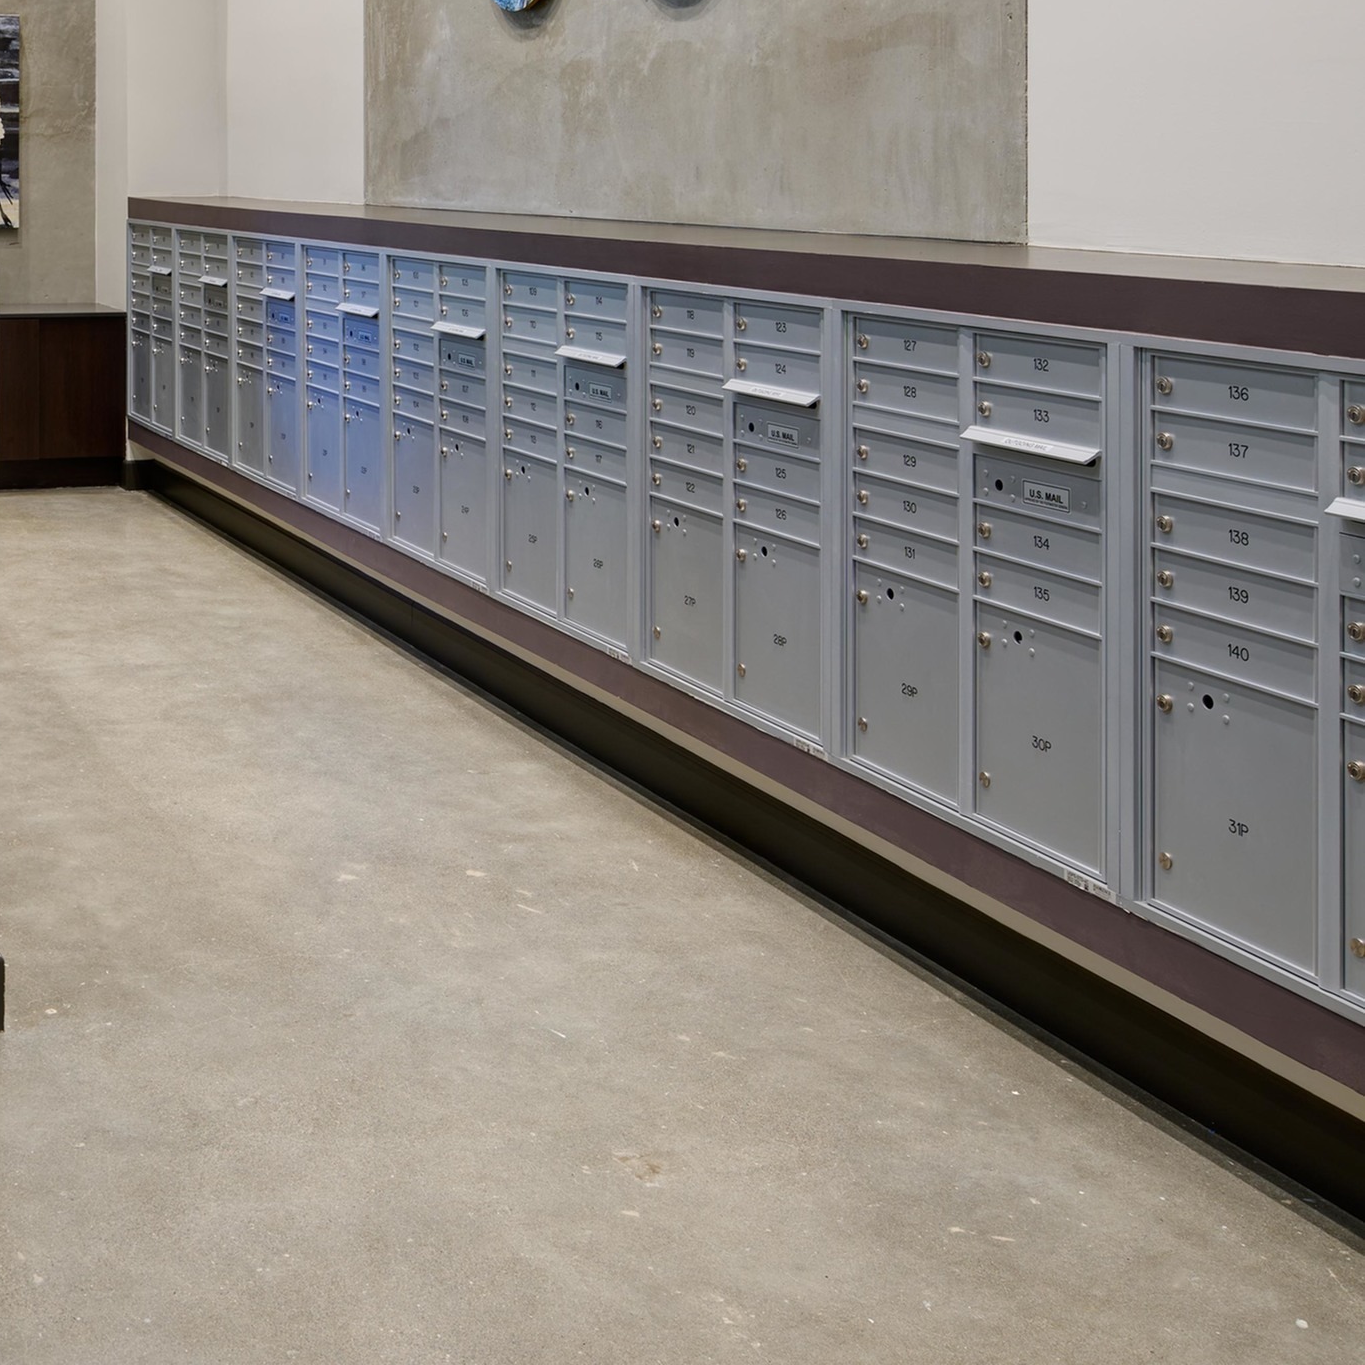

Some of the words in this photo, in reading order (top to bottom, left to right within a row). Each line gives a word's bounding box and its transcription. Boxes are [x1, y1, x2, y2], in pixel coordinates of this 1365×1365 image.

[775, 321, 788, 334] 123
[903, 339, 917, 352] 127
[774, 362, 787, 375] 124
[1033, 357, 1049, 373] 132
[902, 385, 917, 399] 128
[1228, 385, 1250, 402] 136
[685, 404, 697, 416] 120
[1033, 408, 1050, 423] 133
[782, 431, 795, 441] MAIL
[686, 443, 695, 454] 121
[1228, 442, 1249, 459] 137
[902, 454, 917, 468] 129
[775, 467, 787, 480] 125
[685, 481, 696, 494] 122
[1029, 488, 1044, 500] U.S.
[1045, 492, 1064, 504] MAIL
[775, 508, 787, 521] 126
[902, 500, 917, 514] 130
[1033, 535, 1050, 551] 134
[1228, 529, 1250, 547] 138
[904, 545, 916, 560] 131
[1033, 585, 1050, 602] 135
[1228, 586, 1249, 604] 139
[1227, 643, 1250, 662] 140
[901, 682, 918, 698] 29P
[1031, 735, 1052, 753] 30P
[1228, 818, 1249, 837] 31P
